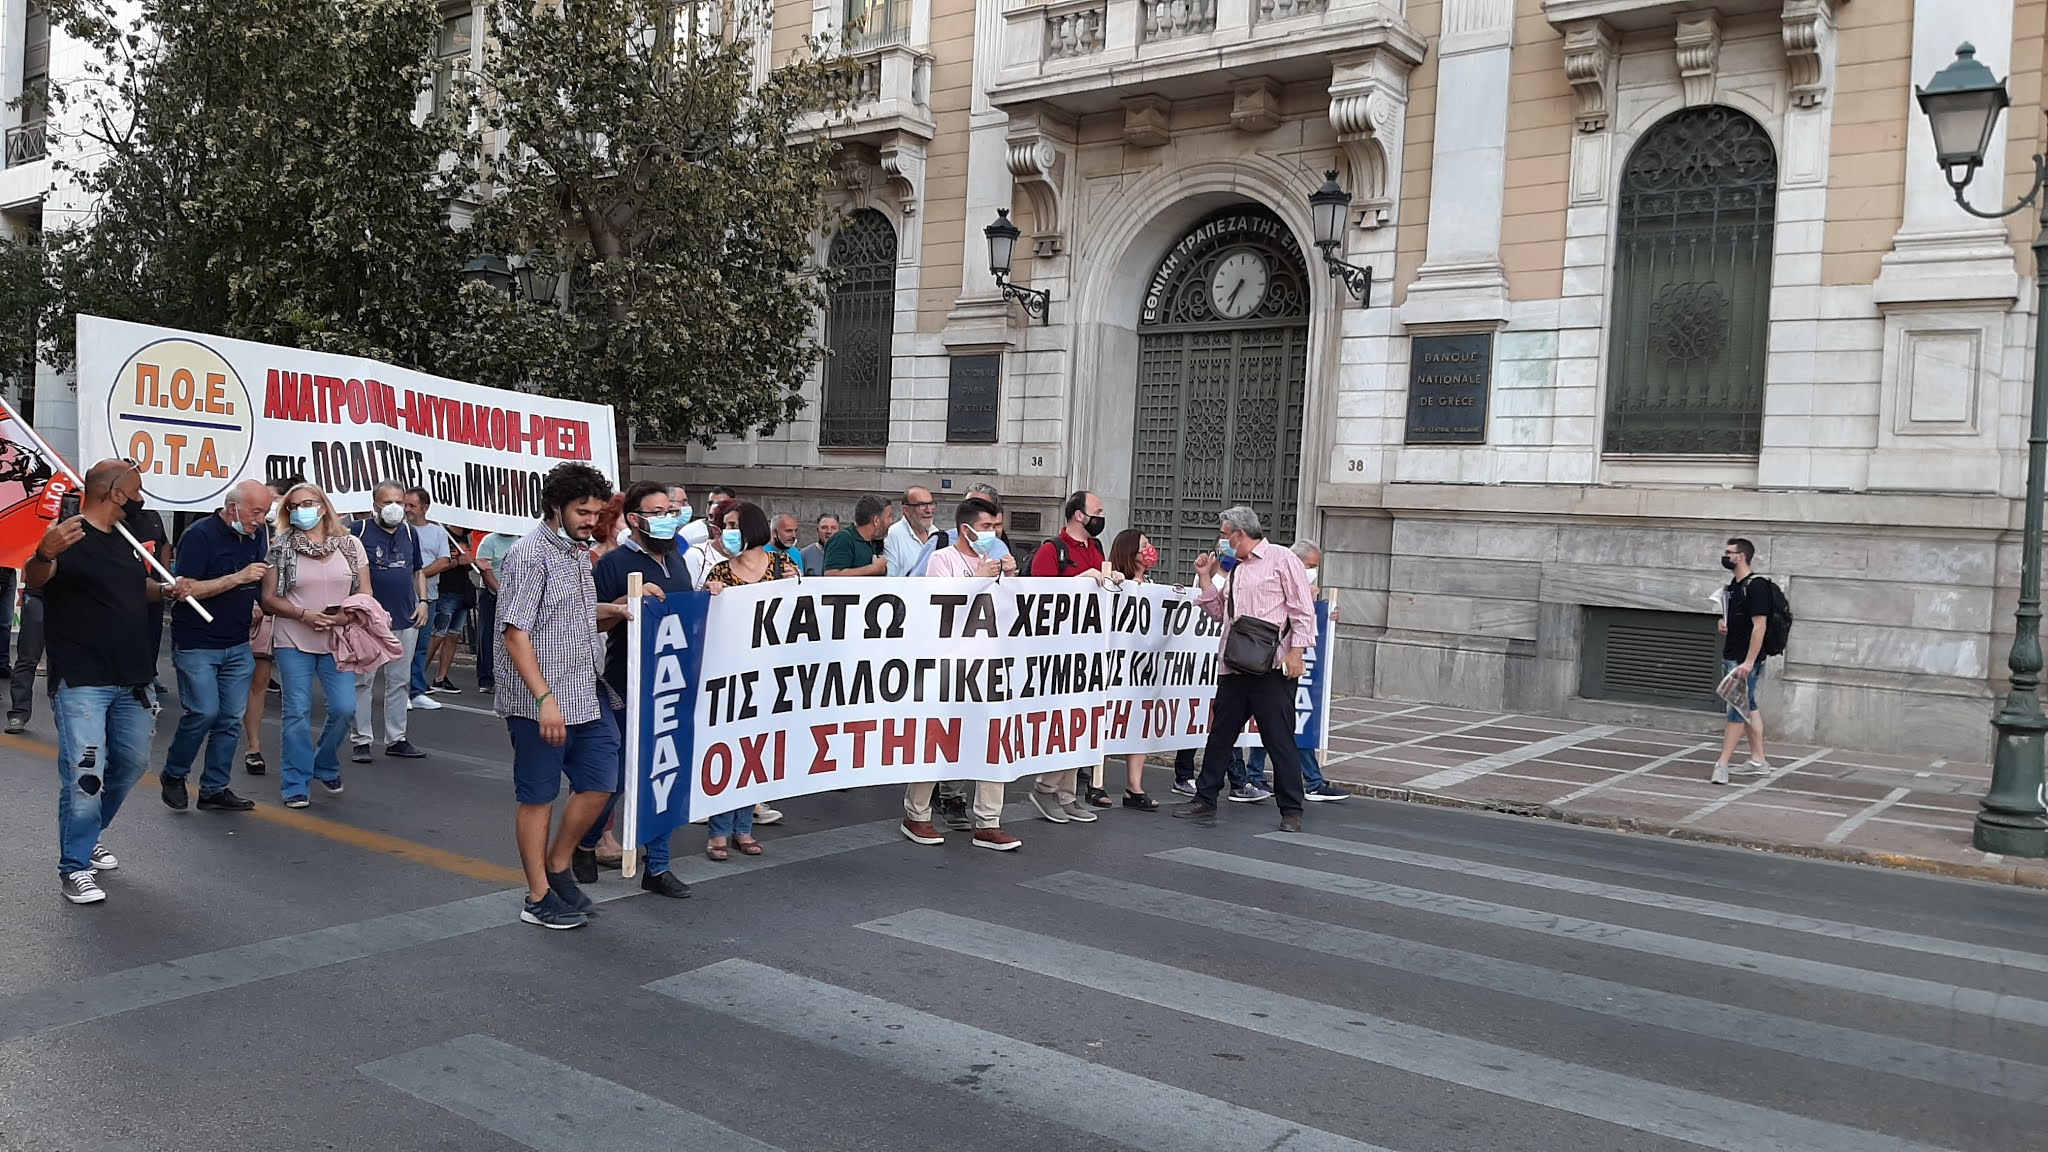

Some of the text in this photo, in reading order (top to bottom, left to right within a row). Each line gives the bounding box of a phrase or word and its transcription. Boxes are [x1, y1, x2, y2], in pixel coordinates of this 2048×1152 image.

[1143, 254, 1179, 322] ΕΘΝΙΚΗ
[1177, 216, 1248, 256] ΤΡΑΠΕΖΑ
[1251, 217, 1281, 239] ΤΗΣ
[1417, 374, 1481, 384] NATIONALE
[1424, 352, 1478, 363] BANQUE
[135, 363, 235, 416] Π.Ο.Ε.
[1420, 397, 1434, 406] DE
[129, 430, 229, 478] Ο.Τ.Α.
[1031, 456, 1043, 466] 38
[1347, 459, 1364, 471] 38
[428, 468, 461, 508] των
[464, 461, 550, 519] ΜΝΗΜΟ
[751, 593, 906, 649] ΚΑΤΩ
[930, 593, 999, 638] ΤΑ
[1008, 593, 1103, 637] ΧΕΡΙΑ
[1162, 599, 1192, 636] ΤΟ
[651, 613, 688, 814] ΑΔΕΔΥ
[705, 670, 759, 726] ΤΙΣ
[771, 657, 1015, 714] ΣΥΛΛΟΓΙΚΕΣ
[1129, 651, 1161, 686] ΚΑΙ
[1162, 652, 1197, 686] ΤΗΝ
[701, 729, 786, 797] ΟΧΙ
[808, 717, 962, 776] ΣΤΗΝ
[1141, 699, 1181, 739] ΤΟΥ
